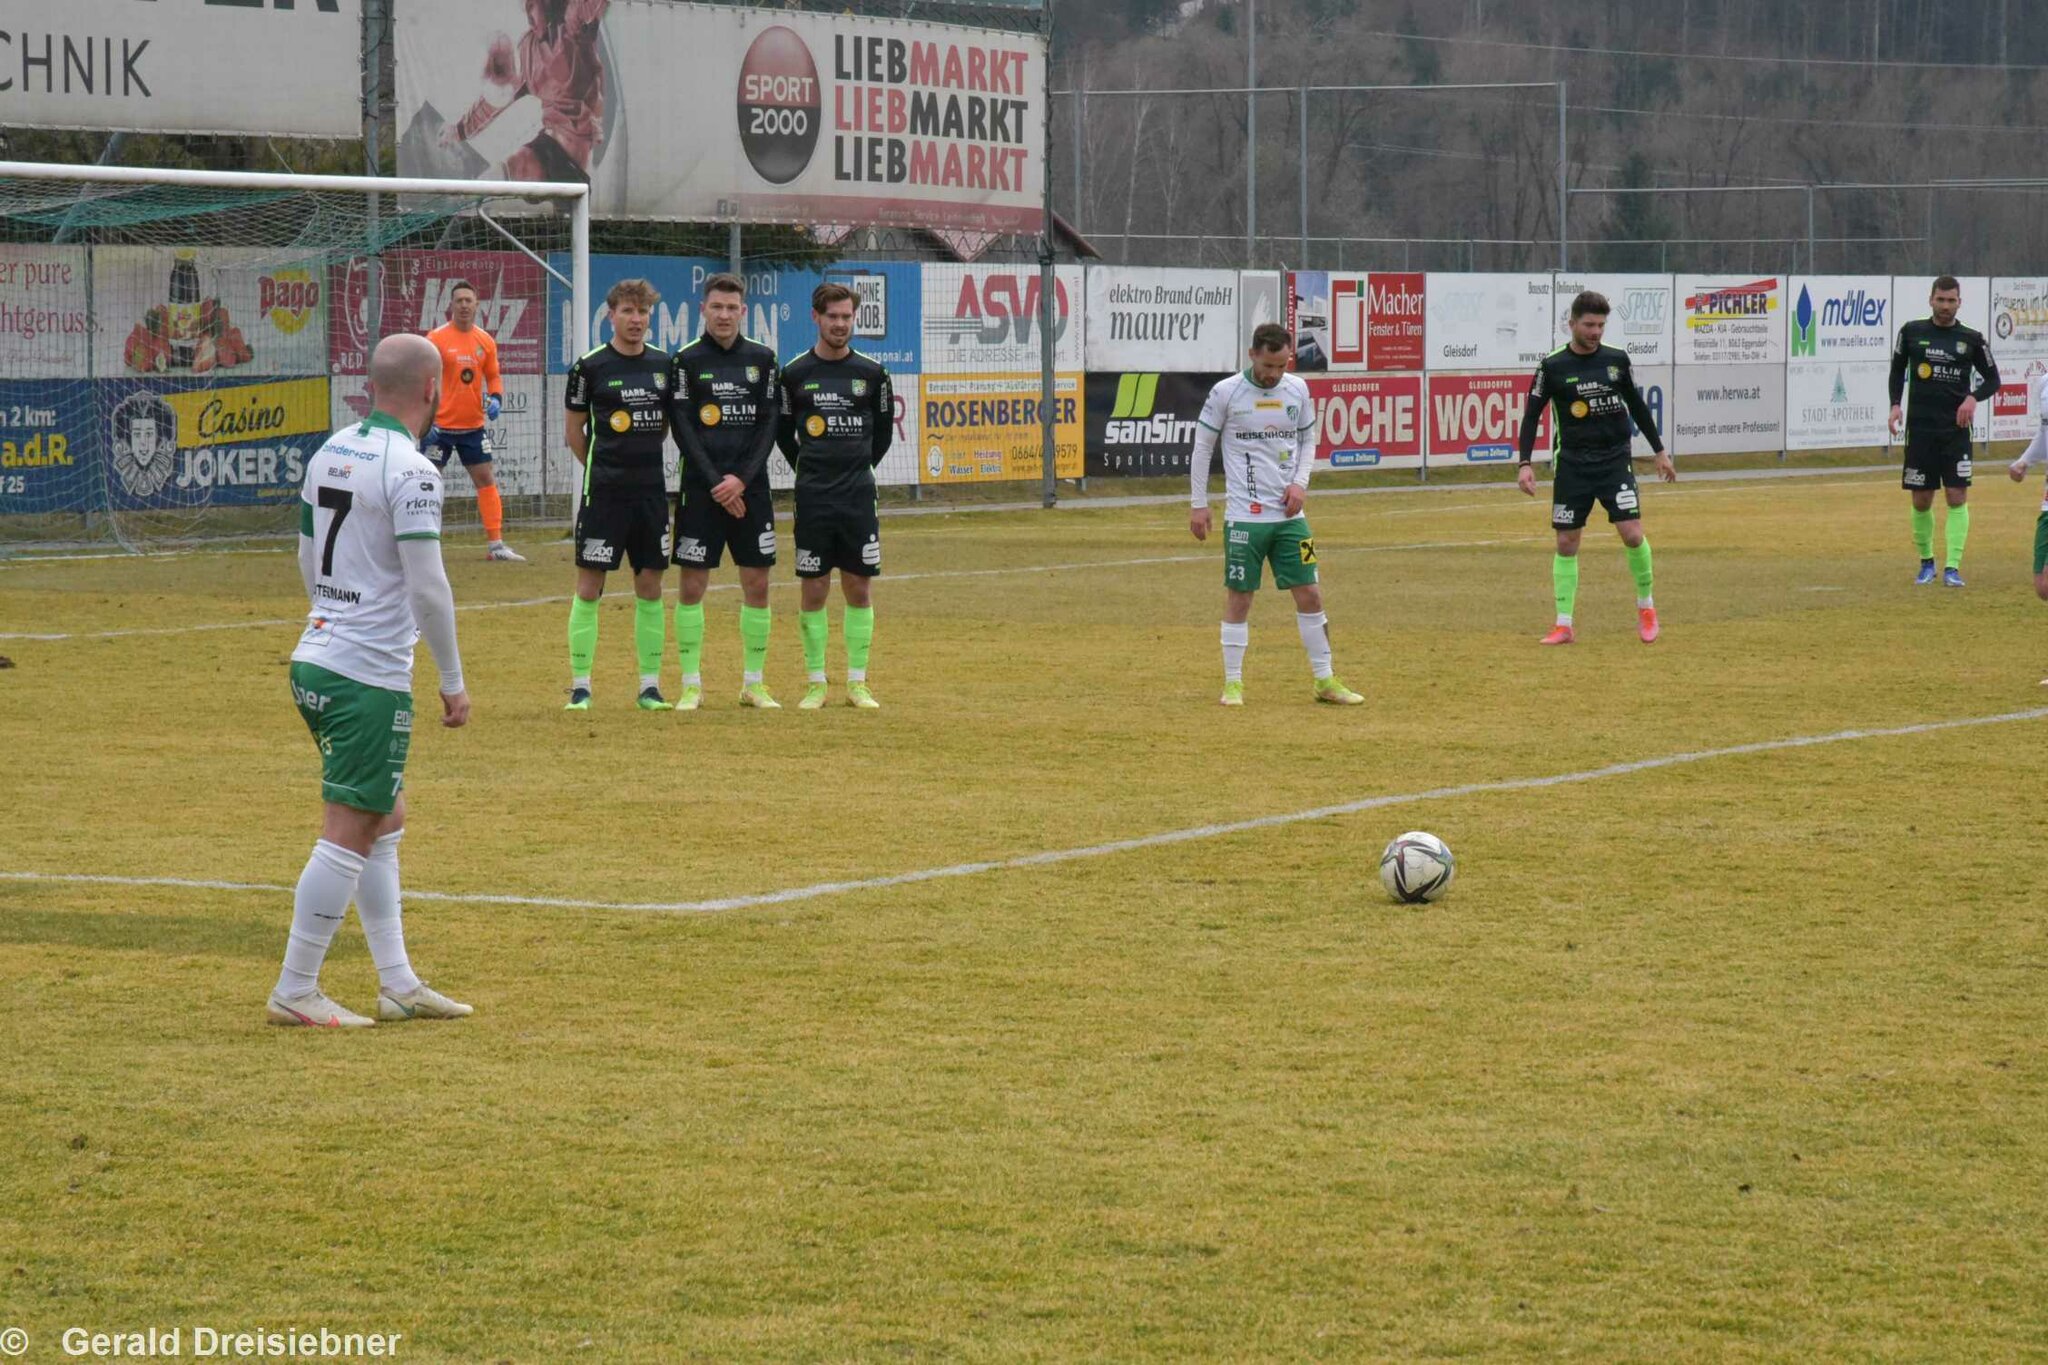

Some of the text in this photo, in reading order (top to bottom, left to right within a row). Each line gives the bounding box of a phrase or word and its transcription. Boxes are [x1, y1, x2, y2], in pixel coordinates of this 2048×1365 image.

[834, 34, 1029, 96] LIEBMARKT
[745, 74, 814, 104] SPORT
[750, 107, 808, 136] 2000
[834, 85, 1029, 144] LIEBMARKT
[834, 135, 1029, 192] LIEBMARKT
[25, 261, 72, 290] pure
[692, 265, 778, 295] Peonal
[1109, 284, 1233, 306] elektro Brand GmbH
[1369, 283, 1424, 316] Macher
[1709, 293, 1768, 315] PICHLER
[857, 304, 884, 329] JOB.
[1821, 289, 1888, 328] müllex
[1, 303, 105, 340] htgenuss.
[1110, 310, 1205, 342] maurer
[1369, 320, 1423, 338] Fenster & Türen
[1444, 344, 1478, 359] Gleisdorf
[1626, 342, 1658, 356] Gleisdorf
[1332, 383, 1380, 393] GLEISDORFER
[1468, 380, 1513, 390] GLEISDORFER
[1697, 385, 1761, 402] www.herwa.at
[198, 396, 285, 438] Casino
[722, 404, 757, 415] ELIN
[827, 415, 864, 427] ELIN
[1676, 424, 1707, 438] Reinigen
[1708, 424, 1717, 435] ist
[1718, 424, 1741, 435] unsere
[176, 444, 303, 487] JOKER'S
[7, 475, 25, 494] 25
[317, 486, 354, 577] 7
[1229, 564, 1246, 581] 23
[392, 771, 404, 796] 7
